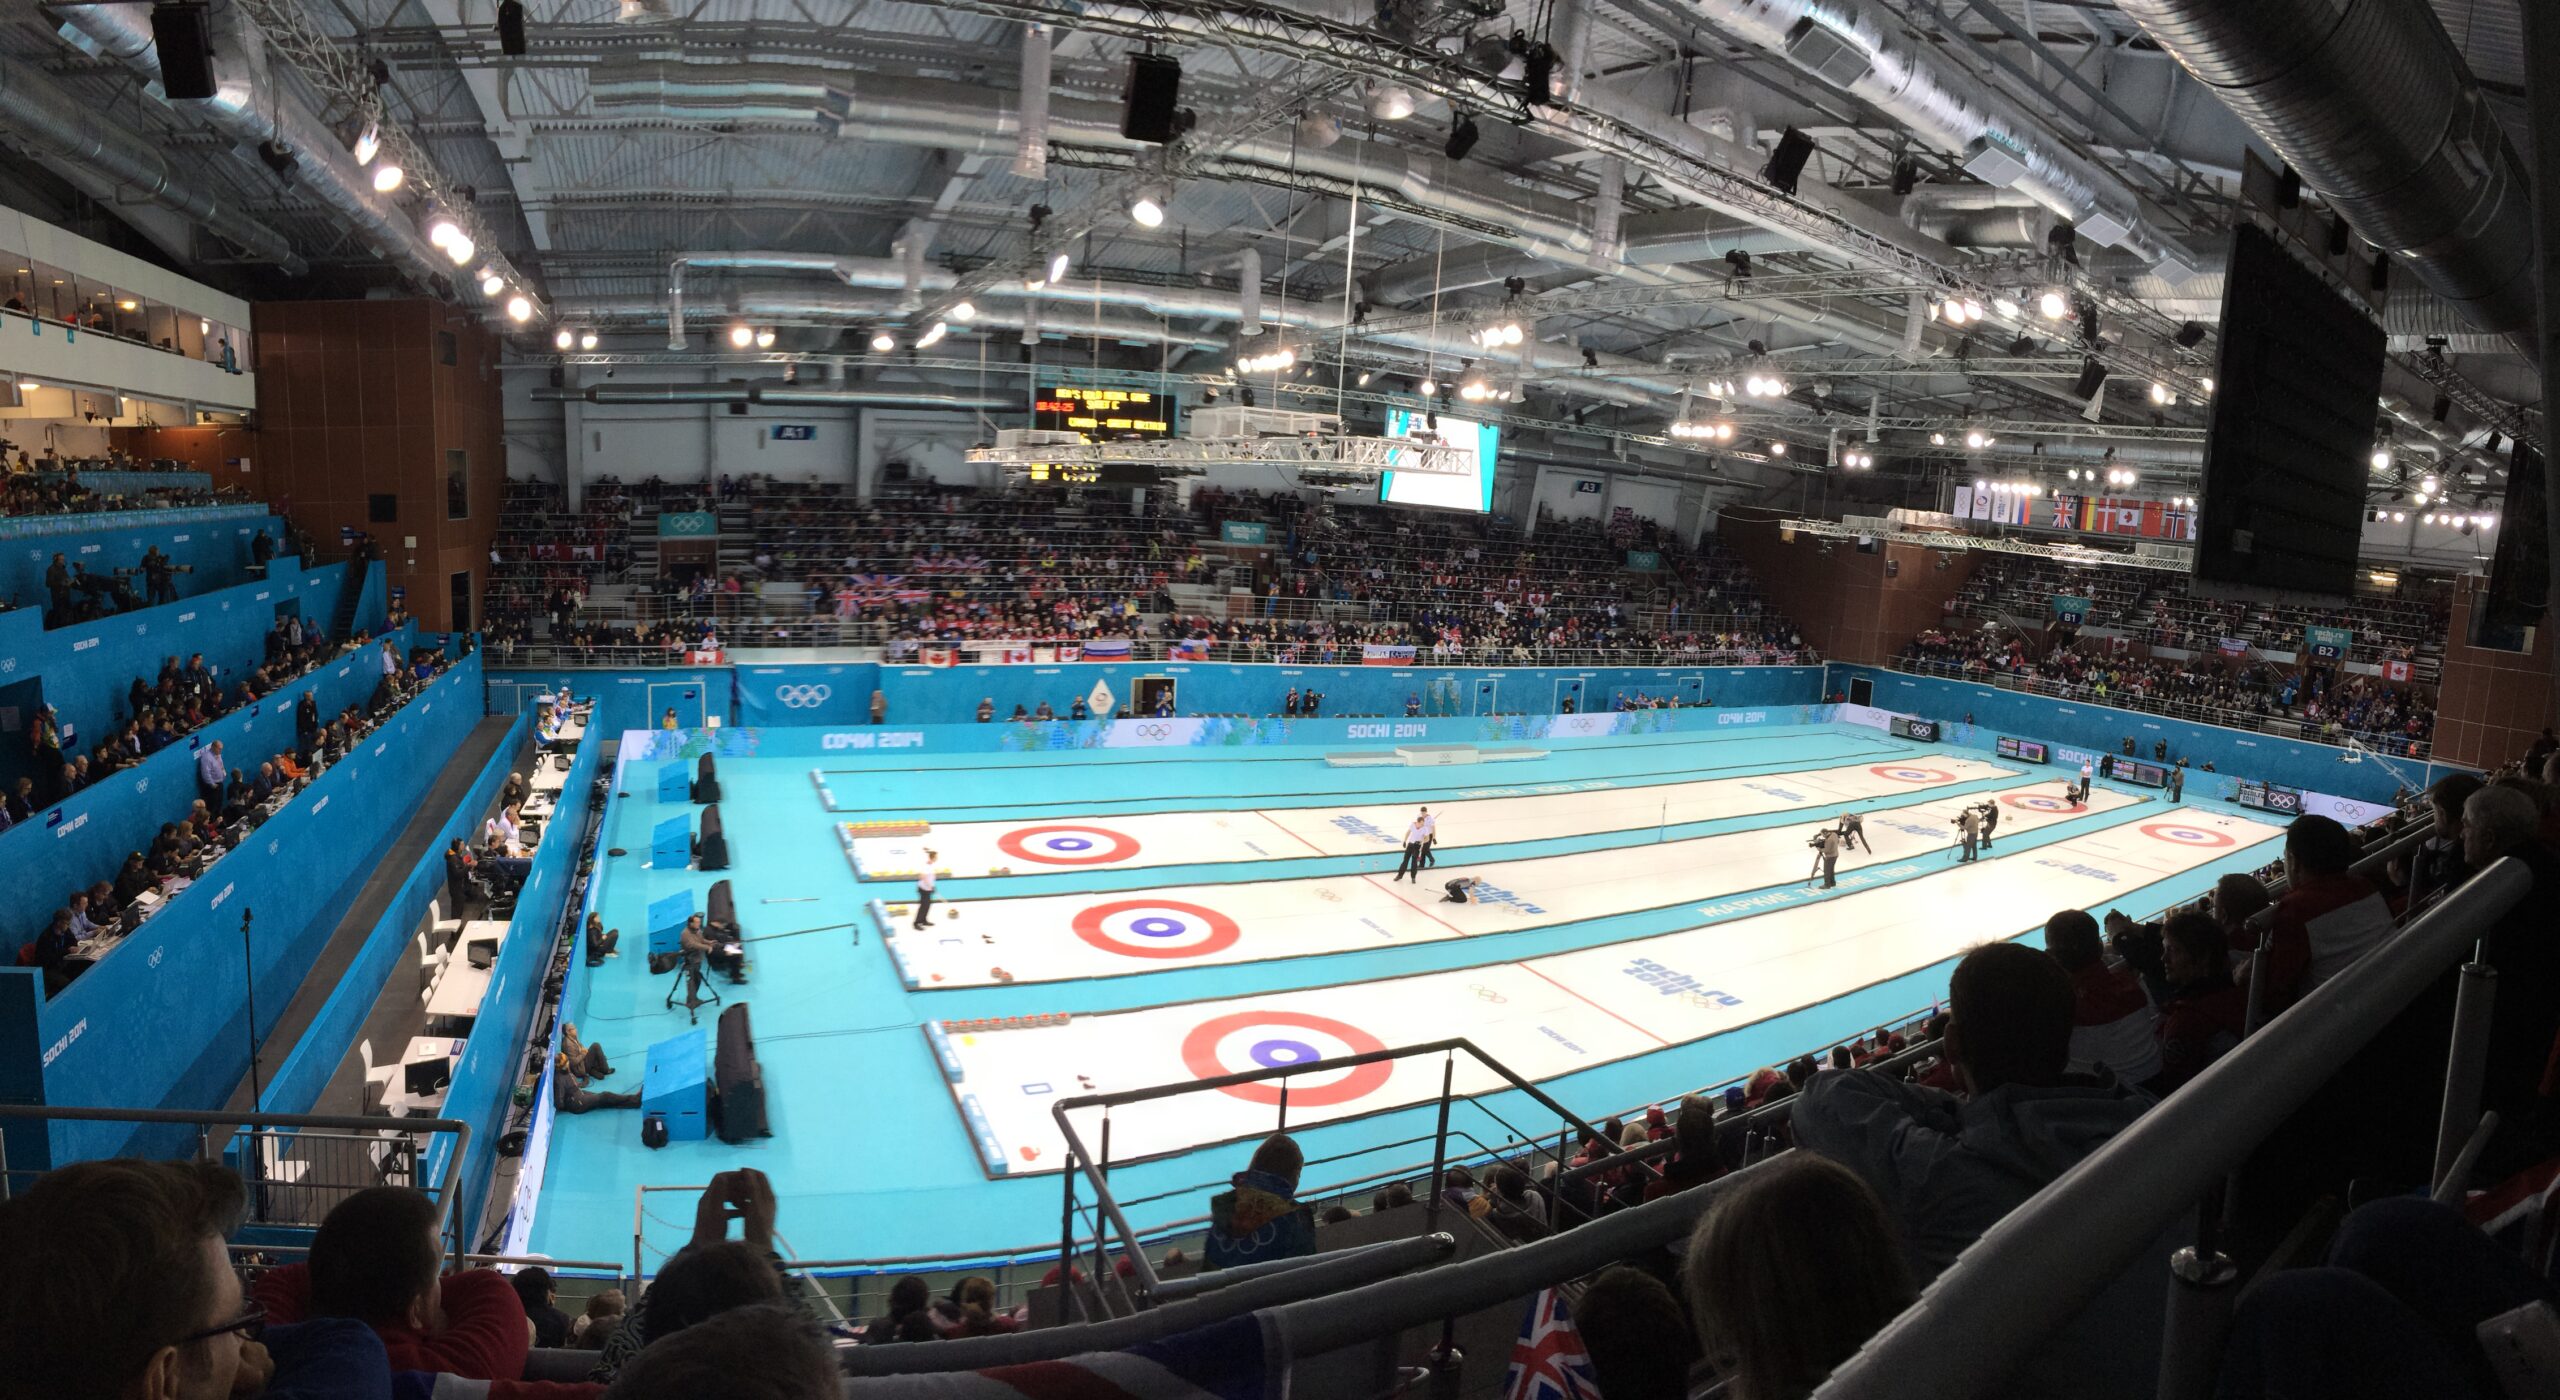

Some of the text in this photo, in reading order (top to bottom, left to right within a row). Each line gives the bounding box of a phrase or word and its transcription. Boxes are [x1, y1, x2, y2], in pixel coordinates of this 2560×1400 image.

[781, 427, 805, 439] A1
[1581, 482, 1597, 493] A3
[2064, 613, 2076, 623] B1
[2314, 630, 2345, 639] sochi.ru
[73, 637, 99, 652] SOCHI 2014
[2318, 646, 2334, 657] B2
[1717, 711, 1766, 725] СОЧИ 2014
[1347, 724, 1426, 739] SOCHI 2014
[822, 732, 924, 750] СОЧИ 2014
[2057, 749, 2092, 764] SOCHI
[2242, 795, 2256, 803] 2014
[57, 822, 74, 838] СОЧИ
[74, 812, 88, 829] 2014
[1622, 967, 1688, 995] 2014
[1629, 958, 1744, 1006] sochi.ru
[42, 1017, 87, 1069] SOCHI 2014
